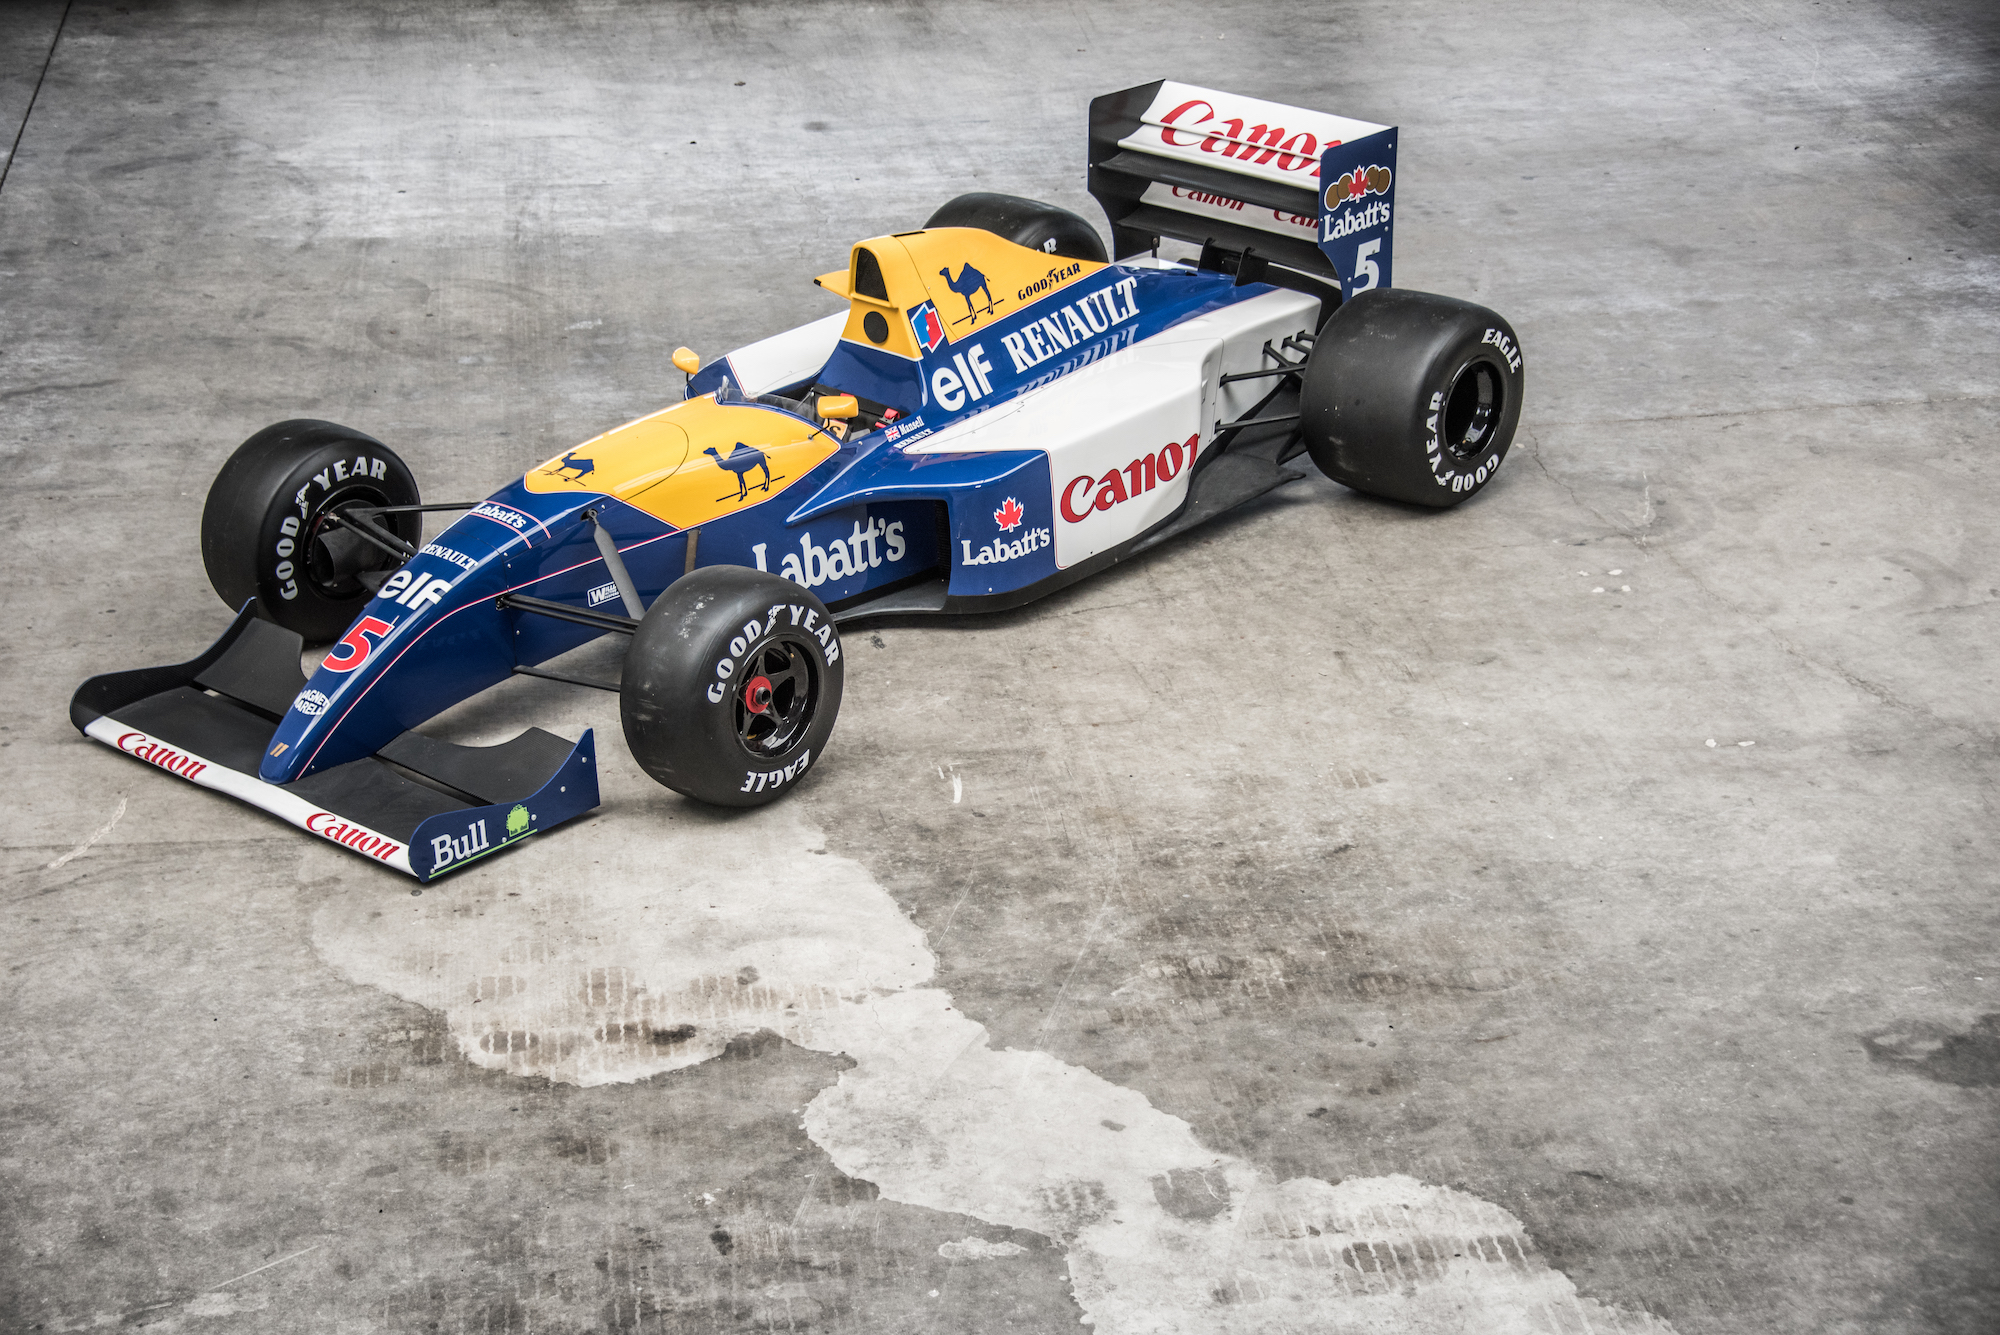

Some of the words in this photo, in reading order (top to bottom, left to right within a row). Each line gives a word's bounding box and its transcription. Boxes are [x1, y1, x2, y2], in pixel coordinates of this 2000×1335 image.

[1273, 209, 1319, 229] Can
[1323, 201, 1390, 243] Labatt's
[1352, 237, 1382, 298] 5
[1001, 276, 1140, 375] RENAULT
[1481, 328, 1521, 374] EAGLE
[931, 343, 994, 412] elf
[893, 428, 934, 449] RENAULT
[898, 415, 925, 436] Mansell
[471, 502, 527, 528] Labatt's
[961, 527, 1050, 566] Labatt's
[377, 569, 453, 611] elf
[321, 615, 395, 673] 5
[117, 732, 207, 780] Canon
[740, 749, 810, 793] EAGLE
[306, 812, 400, 861] Canon
[430, 819, 489, 870] Bull
